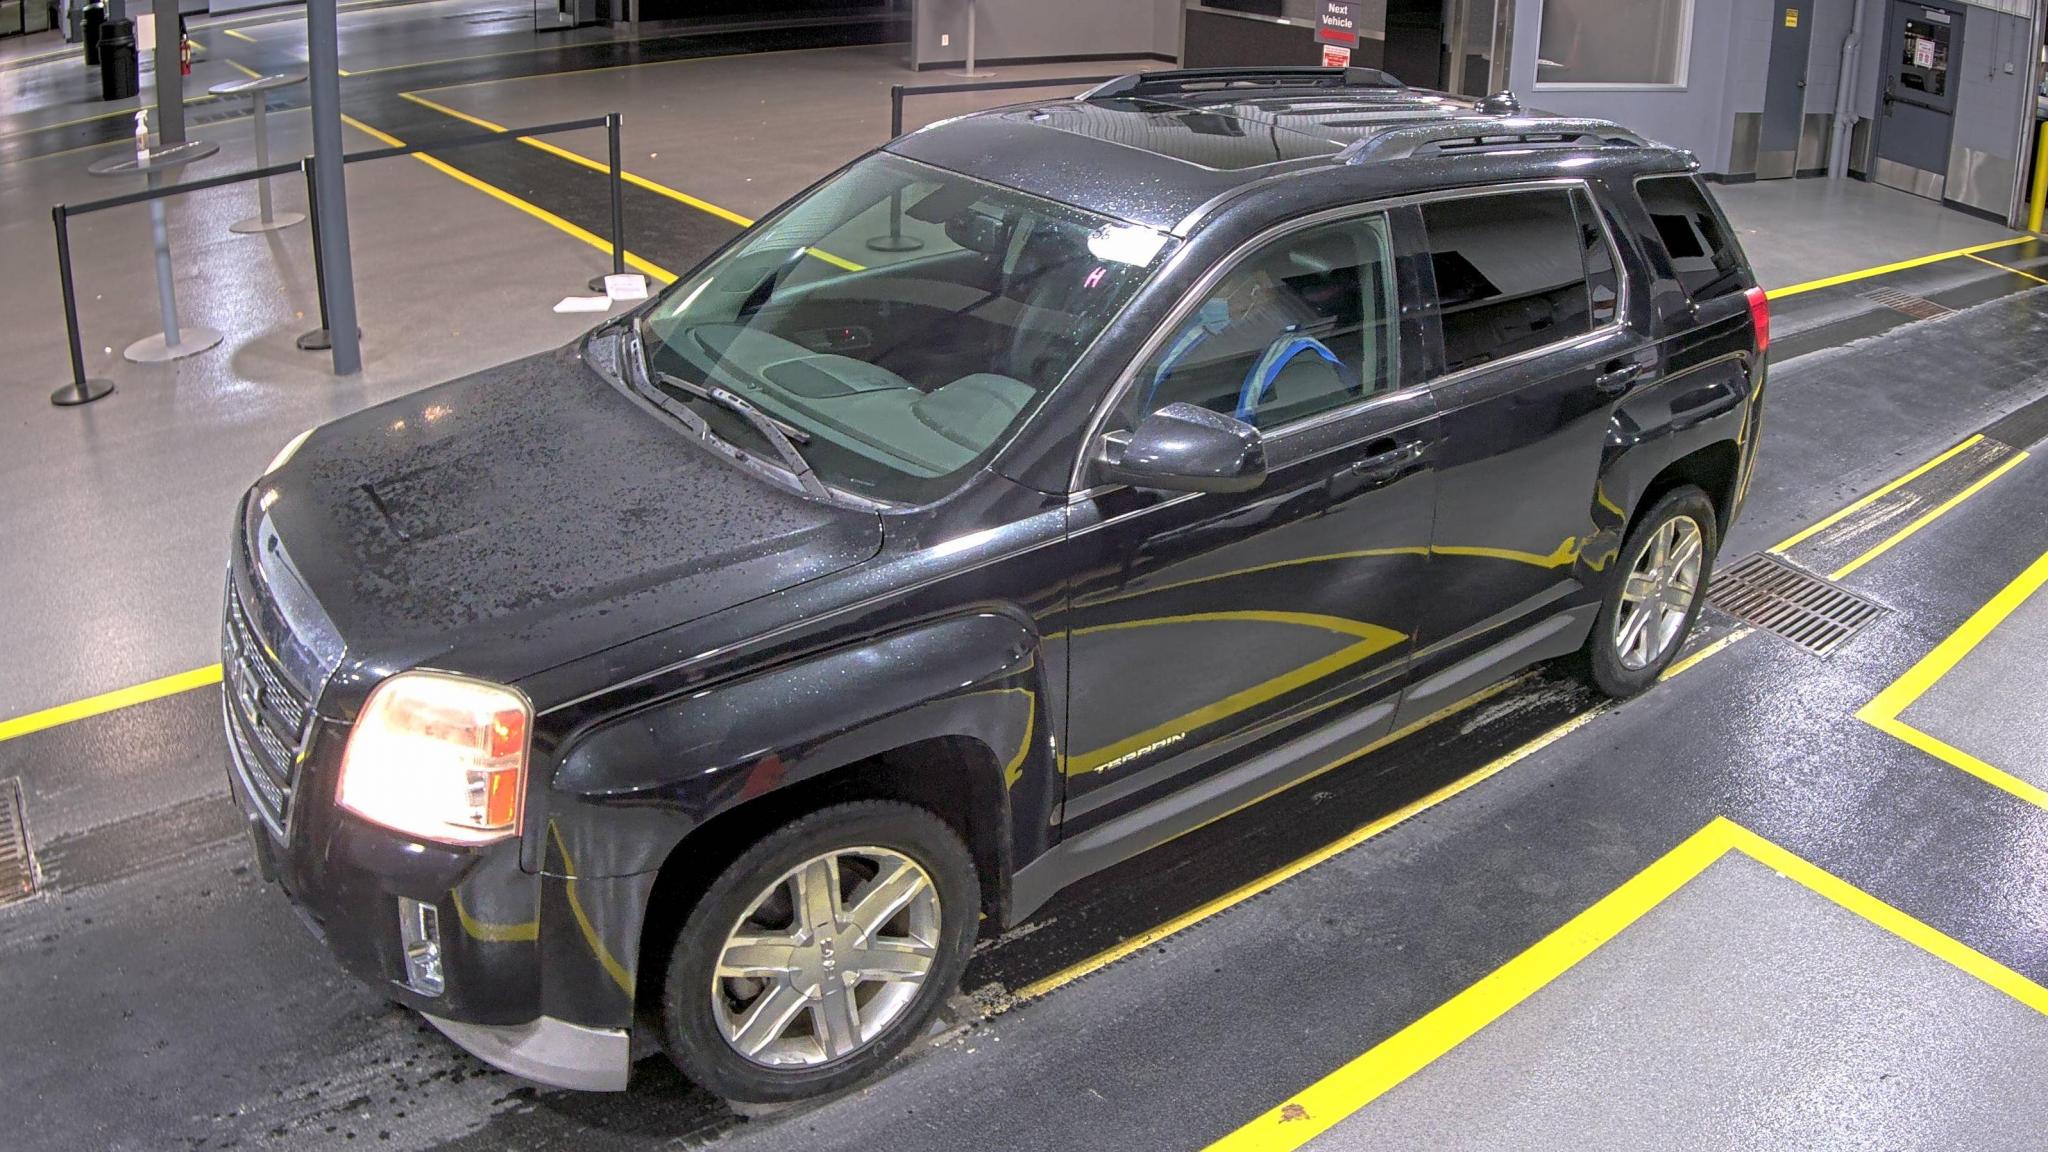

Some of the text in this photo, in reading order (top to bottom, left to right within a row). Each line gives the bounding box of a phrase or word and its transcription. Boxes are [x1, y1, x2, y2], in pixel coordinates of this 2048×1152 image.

[1328, 2, 1348, 15] Next
[1322, 14, 1353, 29] Vehicle
[1093, 732, 1186, 774] TERRAIN
